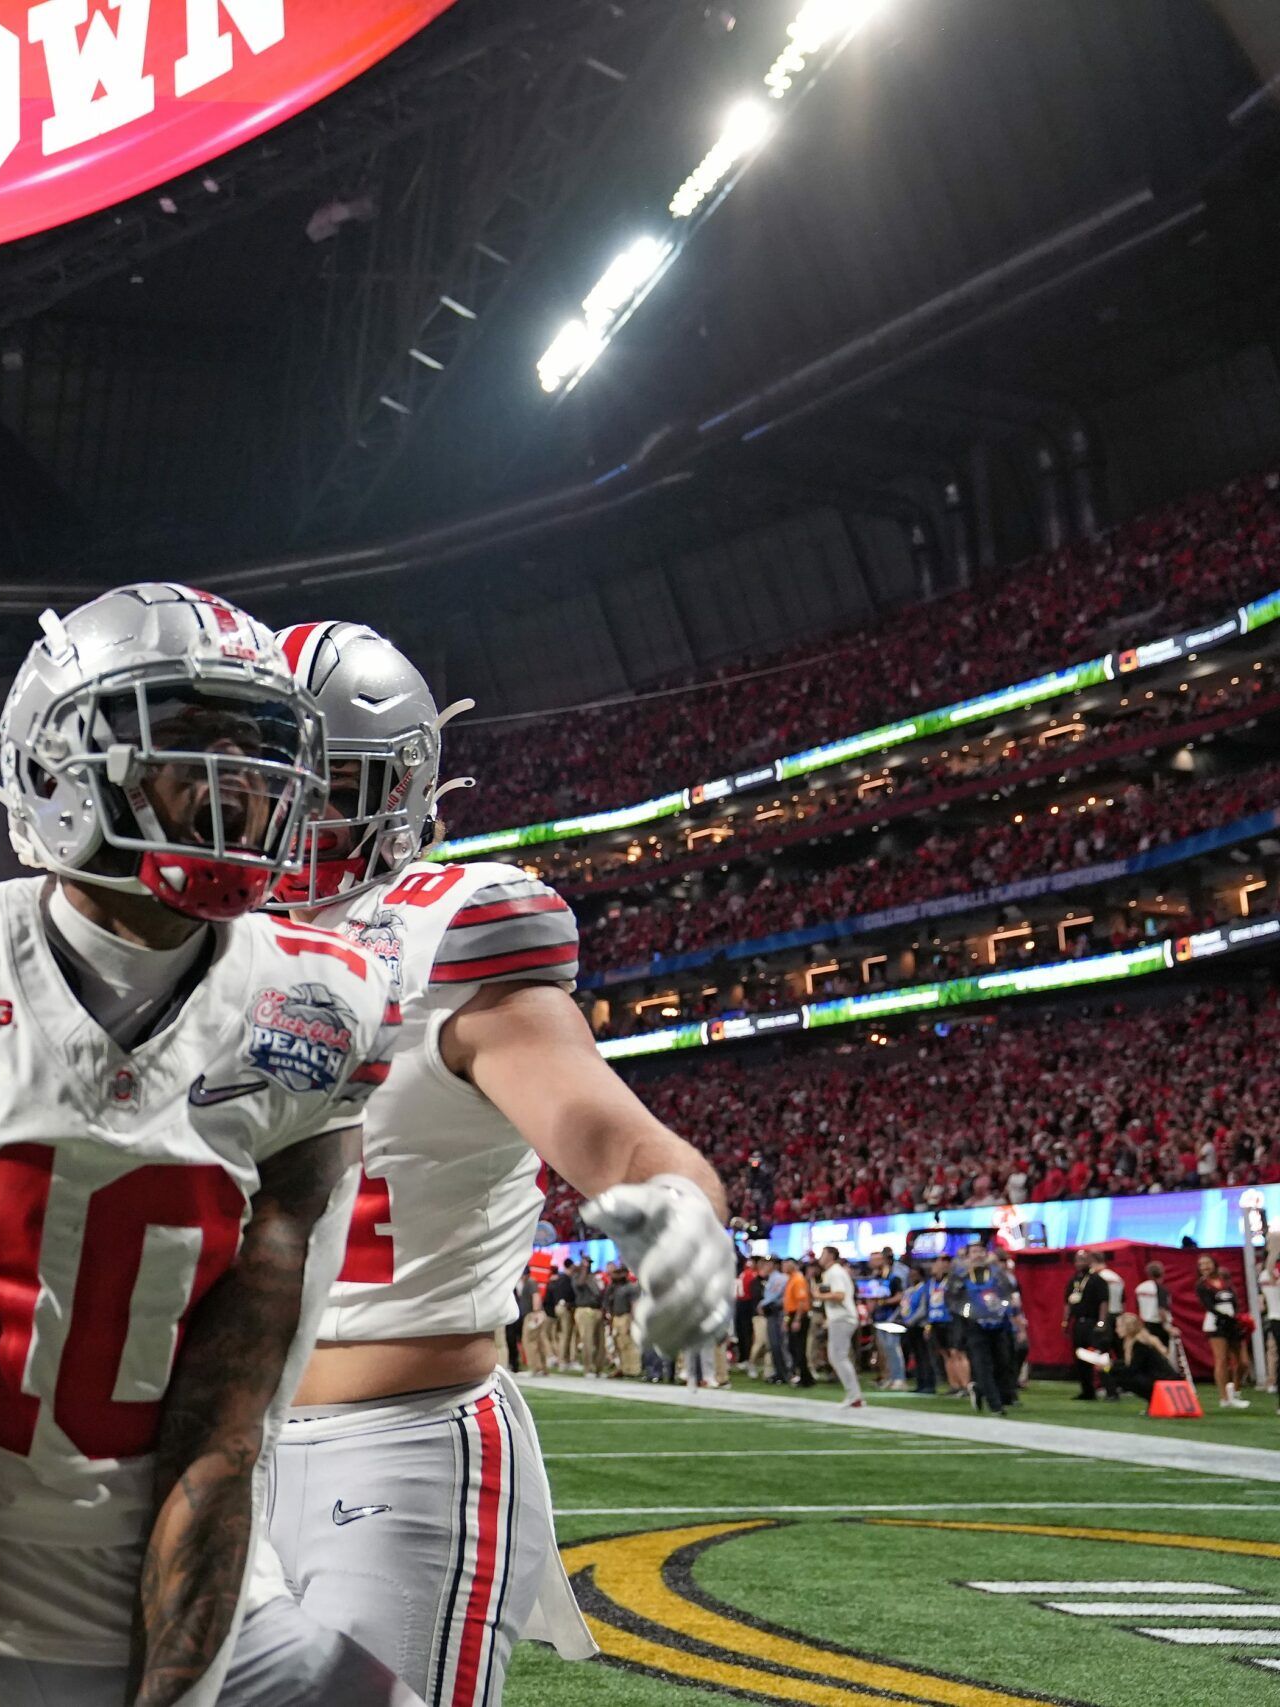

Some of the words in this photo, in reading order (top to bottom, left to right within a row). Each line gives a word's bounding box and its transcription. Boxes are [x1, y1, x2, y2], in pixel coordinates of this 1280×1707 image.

[253, 1027, 344, 1075] PEACH
[268, 1055, 322, 1082] BOWL
[1166, 1385, 1196, 1412] 10
